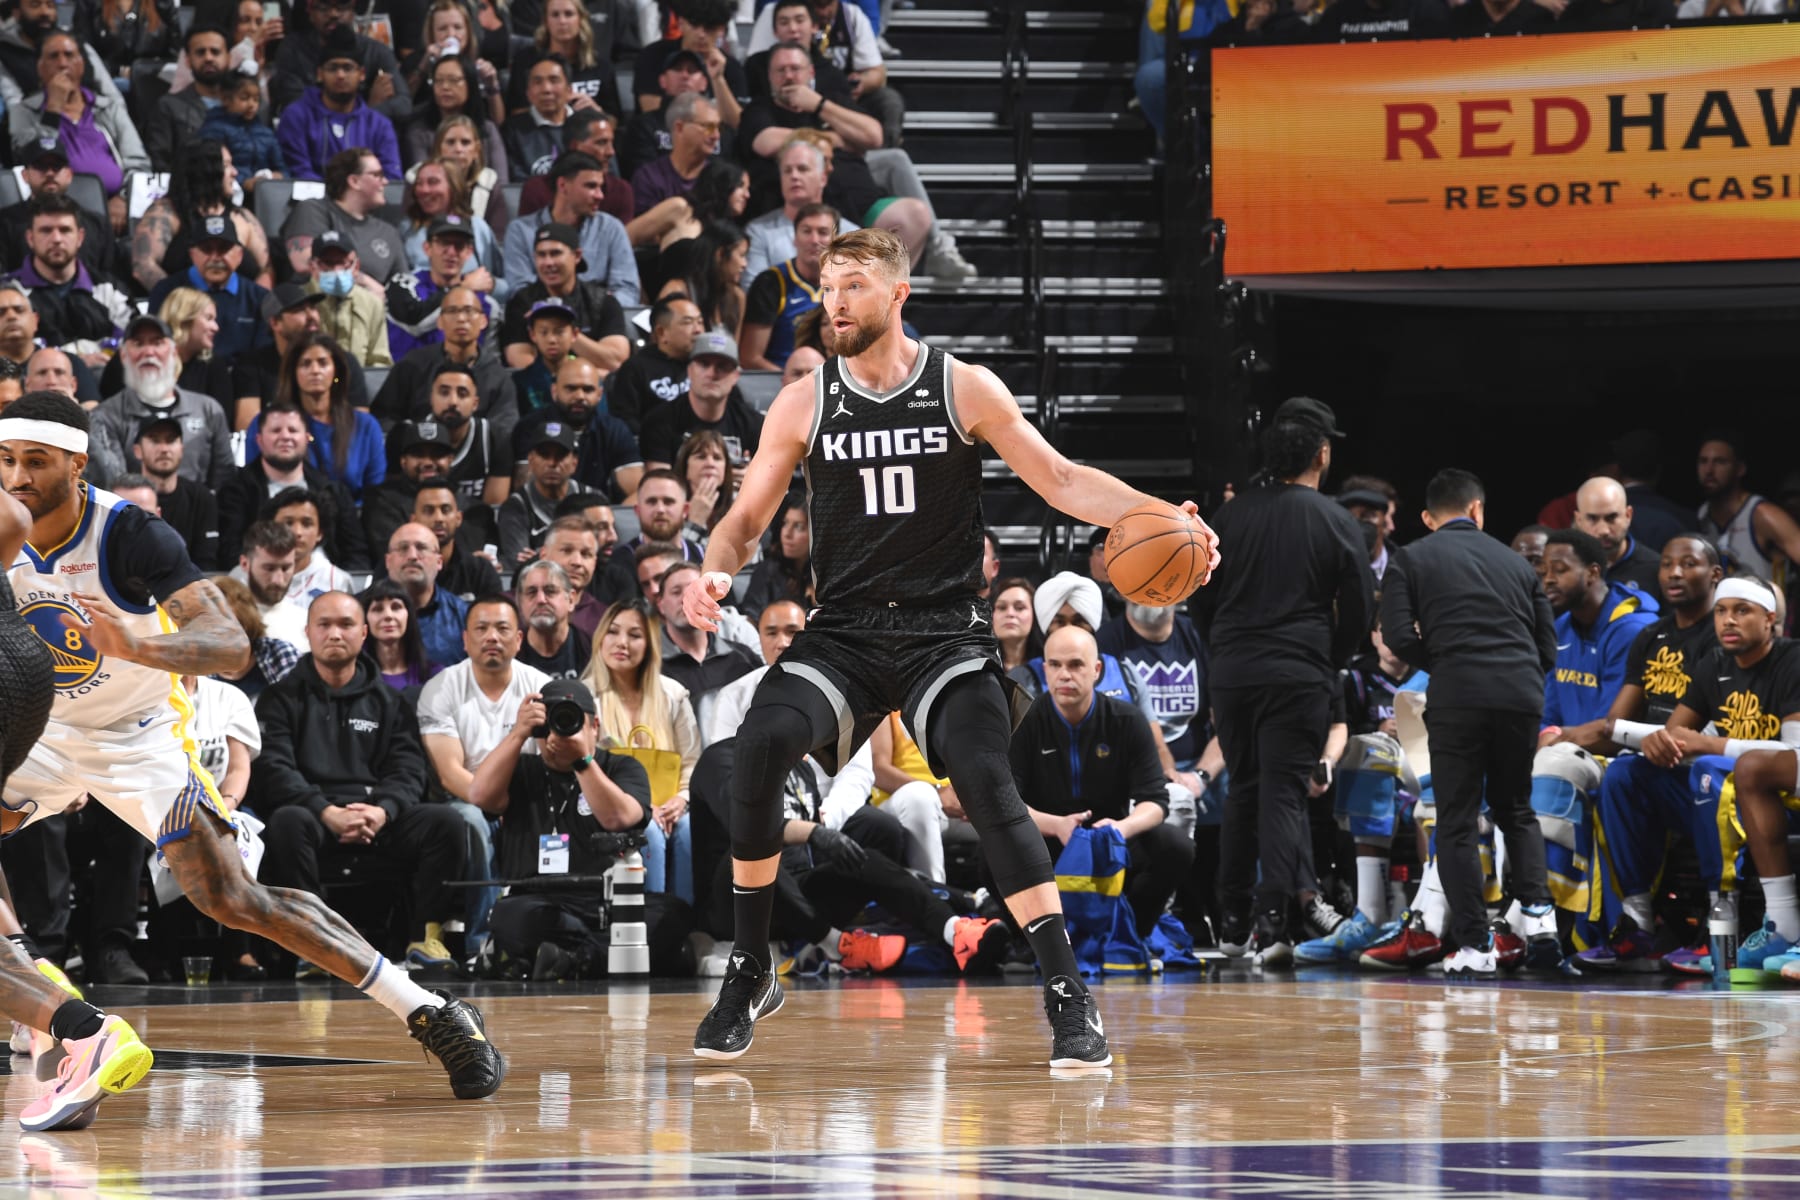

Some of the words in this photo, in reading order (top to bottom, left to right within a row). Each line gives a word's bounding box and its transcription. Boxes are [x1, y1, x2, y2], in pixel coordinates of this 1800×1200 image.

[1444, 181, 1621, 210] RESORT
[1688, 174, 1800, 202] CASI
[829, 382, 840, 395] 6
[907, 399, 939, 409] dialpad
[822, 426, 948, 461] KINGS
[859, 465, 916, 516] 10
[60, 562, 97, 574] Rakuten
[16, 590, 56, 608] LDEN
[64, 628, 83, 650] 8
[56, 671, 112, 699] IORS
[1151, 696, 1195, 713] NGS
